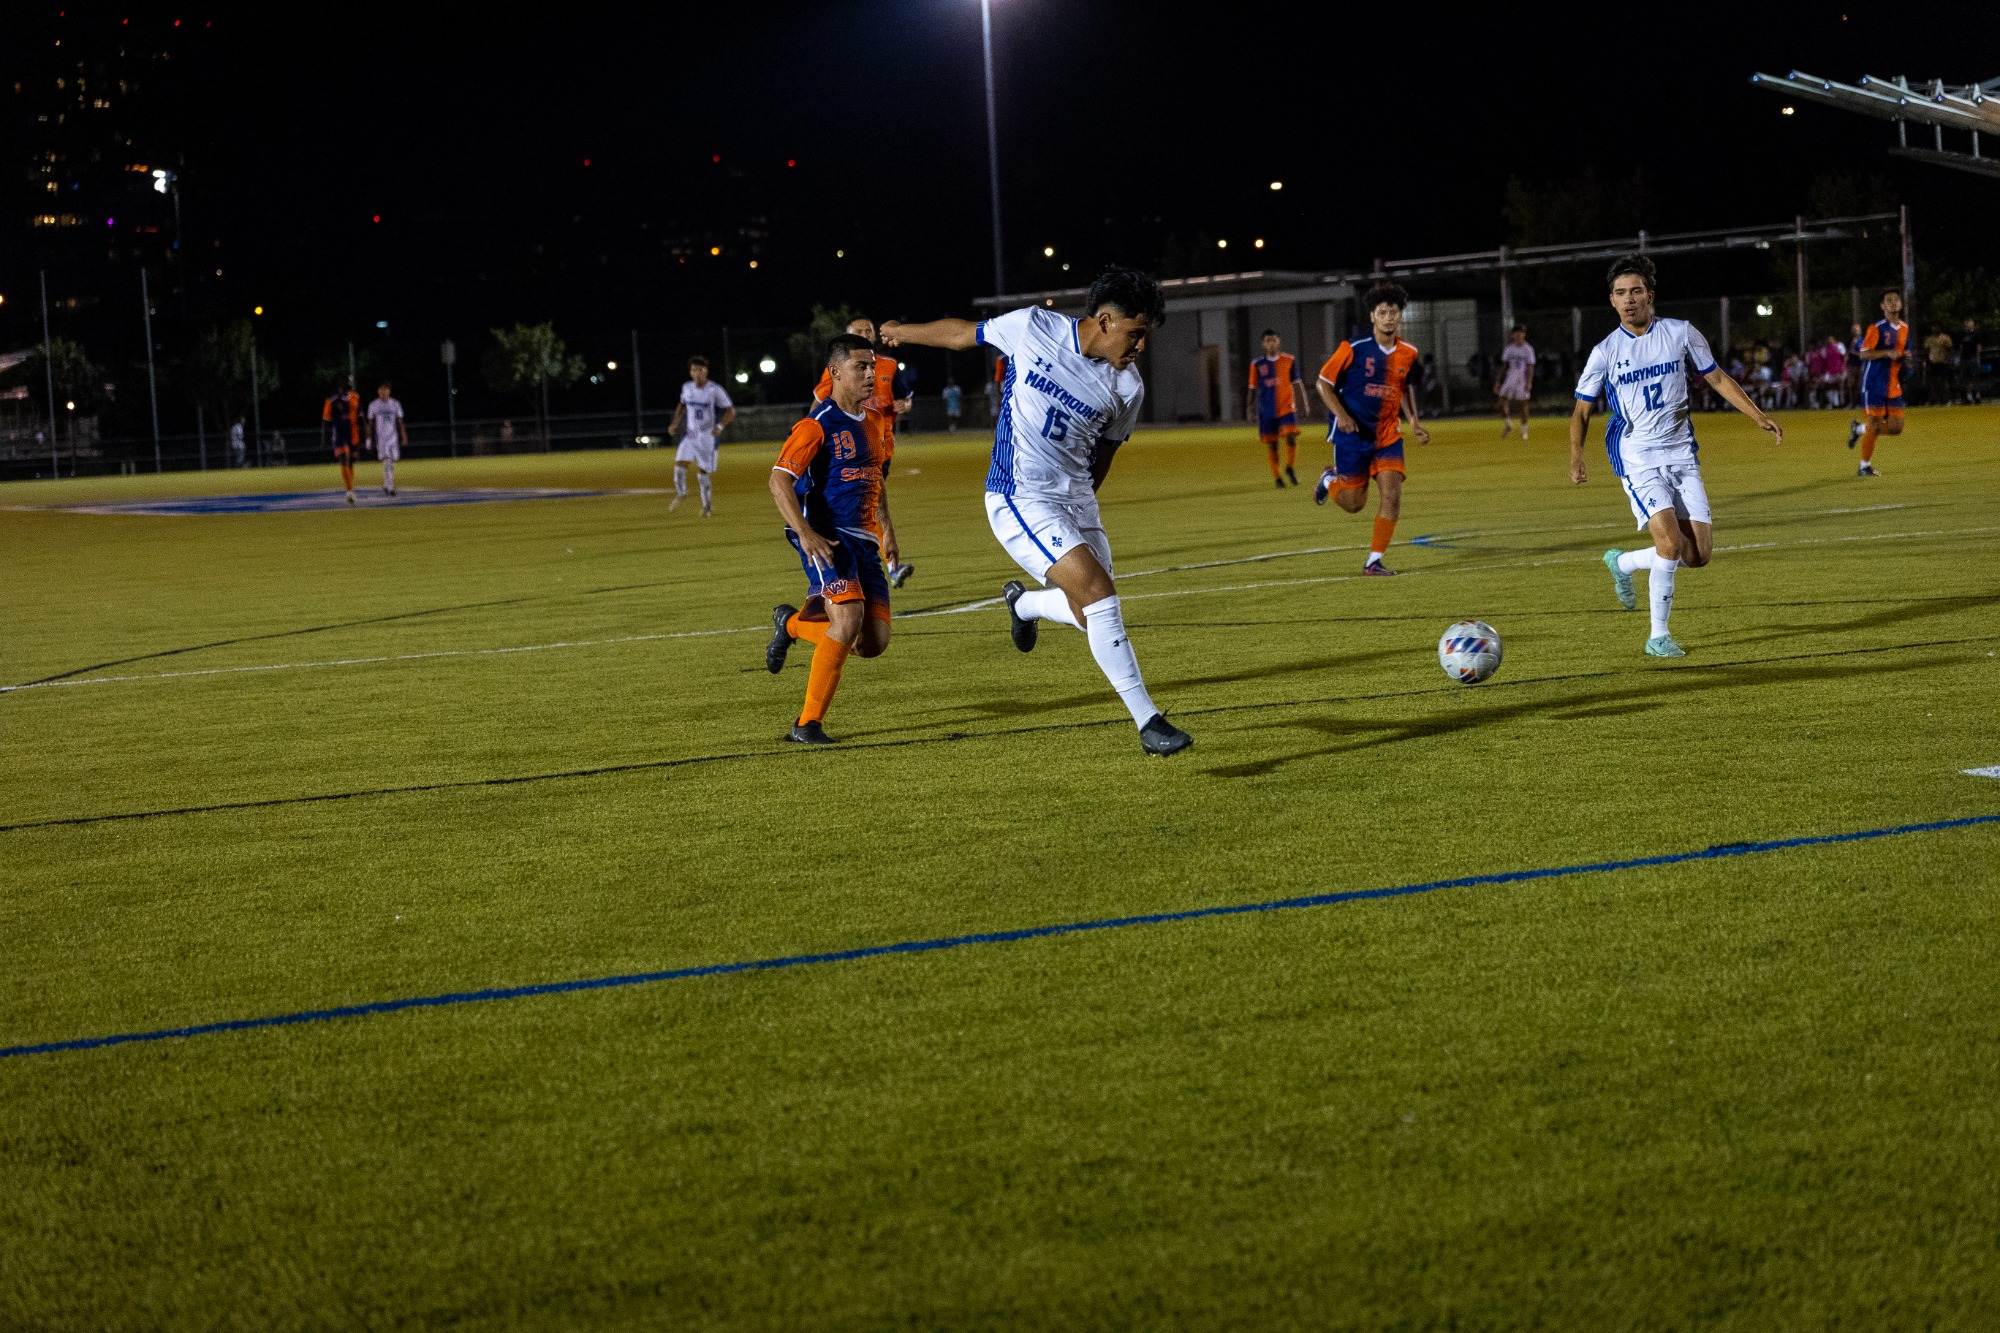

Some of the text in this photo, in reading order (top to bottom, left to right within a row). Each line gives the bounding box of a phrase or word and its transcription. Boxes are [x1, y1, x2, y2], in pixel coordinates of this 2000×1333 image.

[1365, 357, 1375, 378] 5
[1618, 360, 1680, 385] MARYMOUNT
[1025, 369, 1103, 423] MARYMOUNT
[1643, 382, 1665, 412] 12
[1041, 405, 1071, 441] 15
[831, 430, 856, 459] 19
